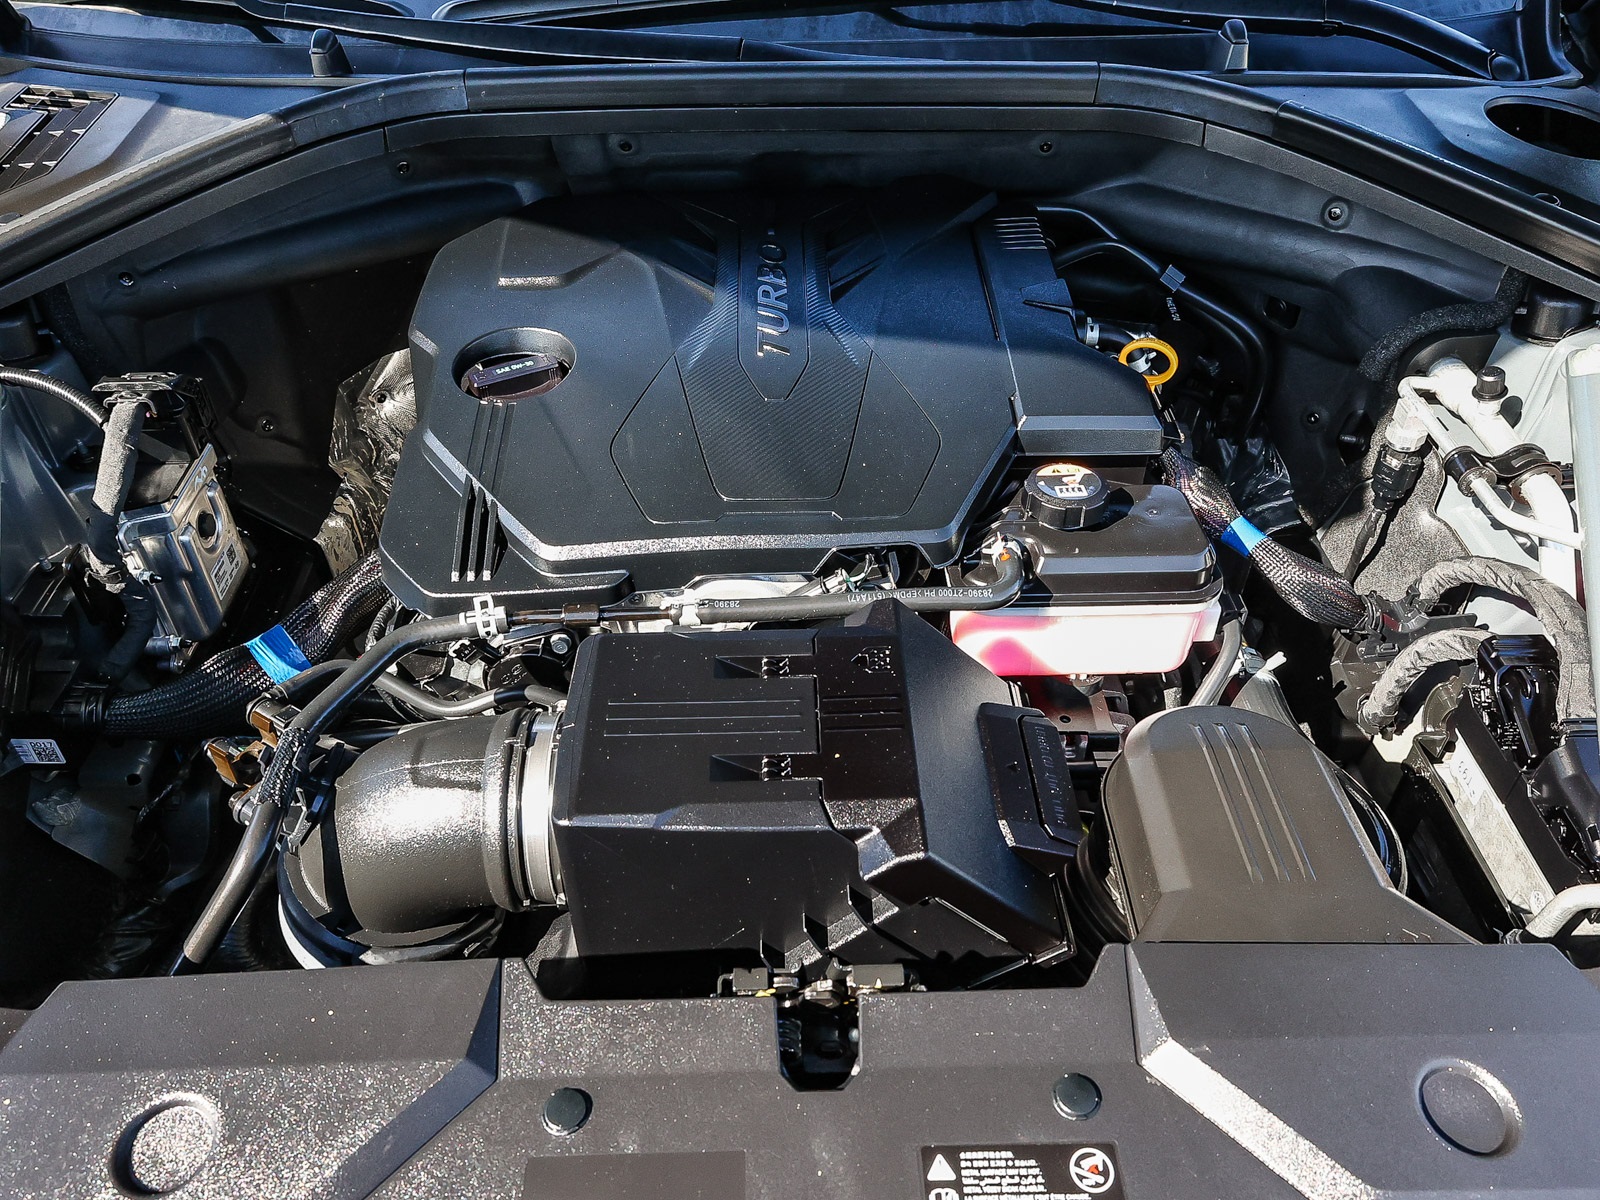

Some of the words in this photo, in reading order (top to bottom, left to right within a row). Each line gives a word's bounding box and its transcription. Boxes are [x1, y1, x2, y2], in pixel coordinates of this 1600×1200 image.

[756, 241, 791, 357] TURBO
[495, 366, 510, 375] SAE
[924, 589, 936, 598] PH
[938, 588, 993, 599] 28390-2T000
